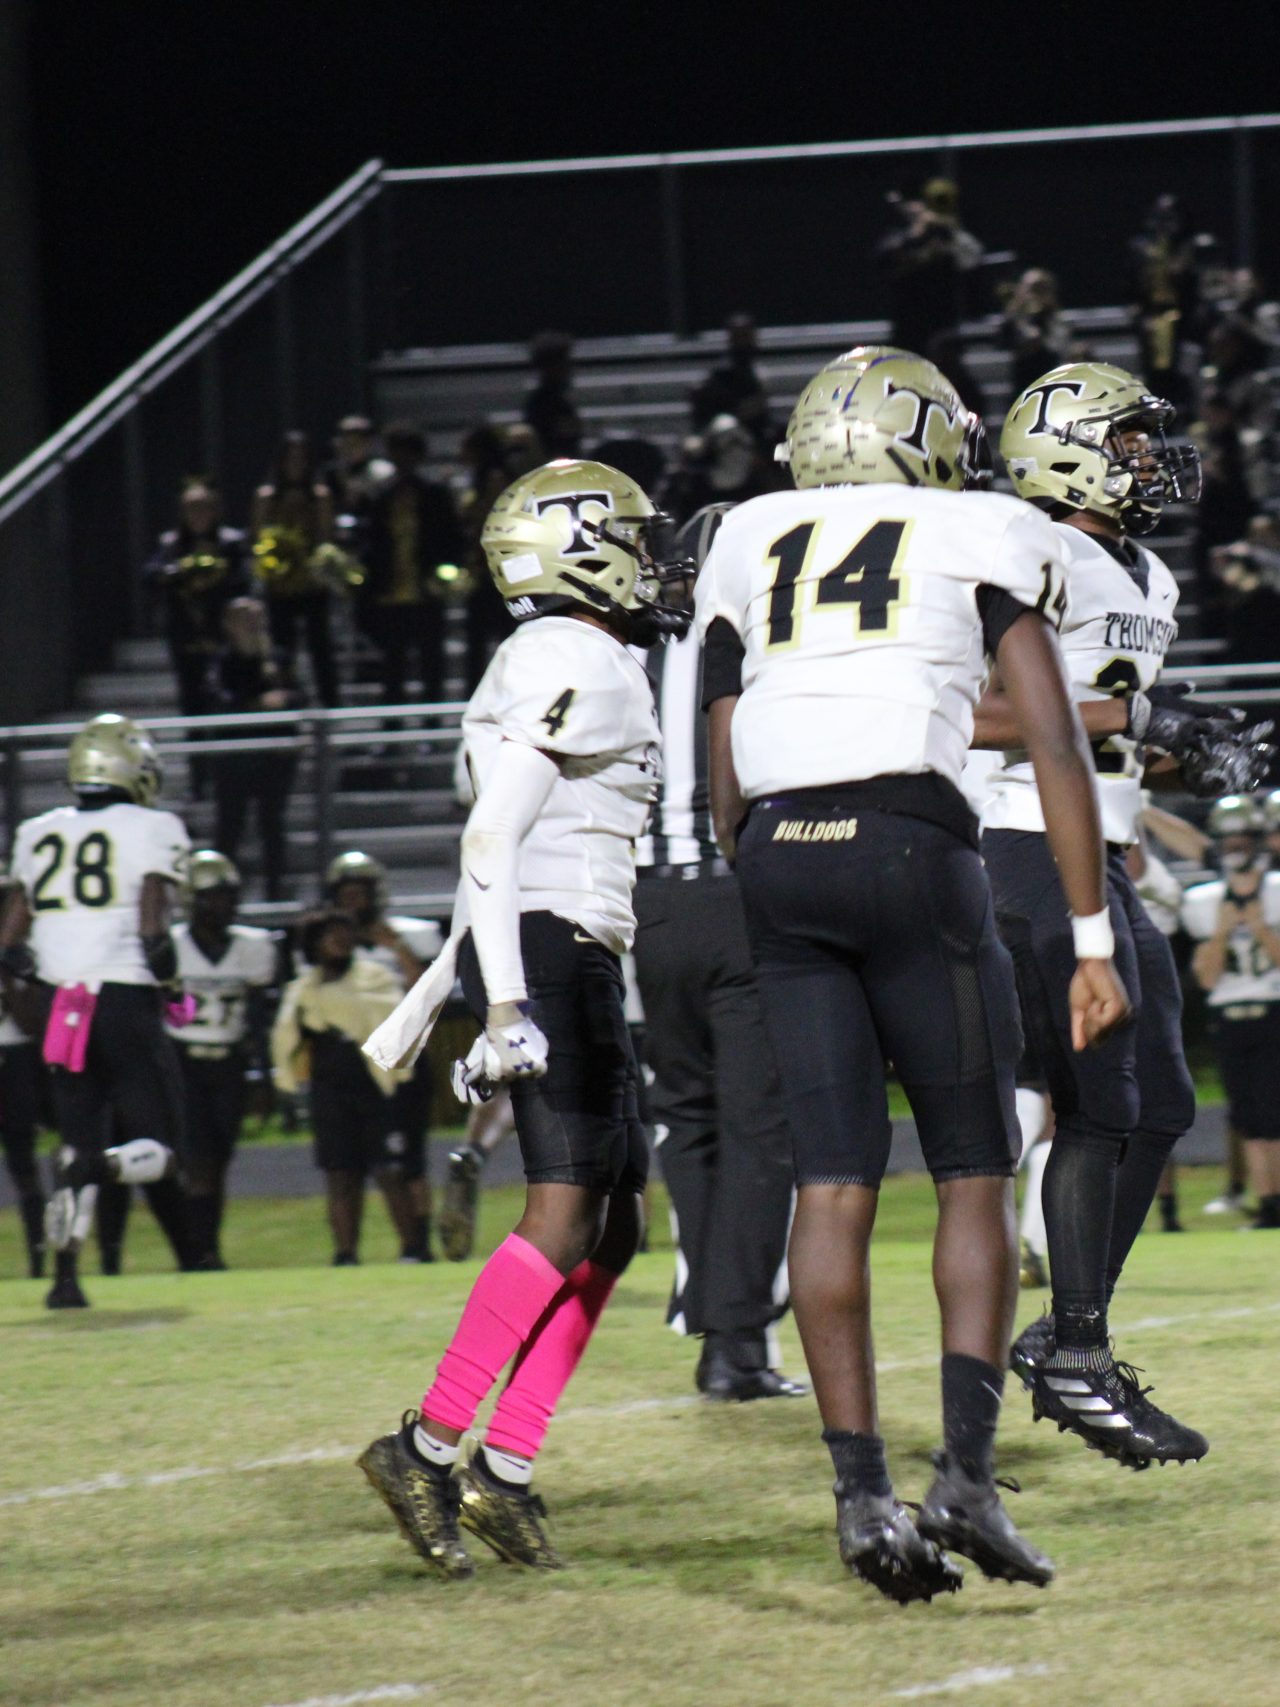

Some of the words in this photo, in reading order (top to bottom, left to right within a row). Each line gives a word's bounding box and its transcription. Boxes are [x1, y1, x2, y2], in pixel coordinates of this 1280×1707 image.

[764, 517, 914, 652] 14
[1105, 612, 1178, 656] THOMSO
[540, 687, 577, 737] 4
[772, 818, 858, 842] BULLDOGS
[32, 831, 117, 912] 28
